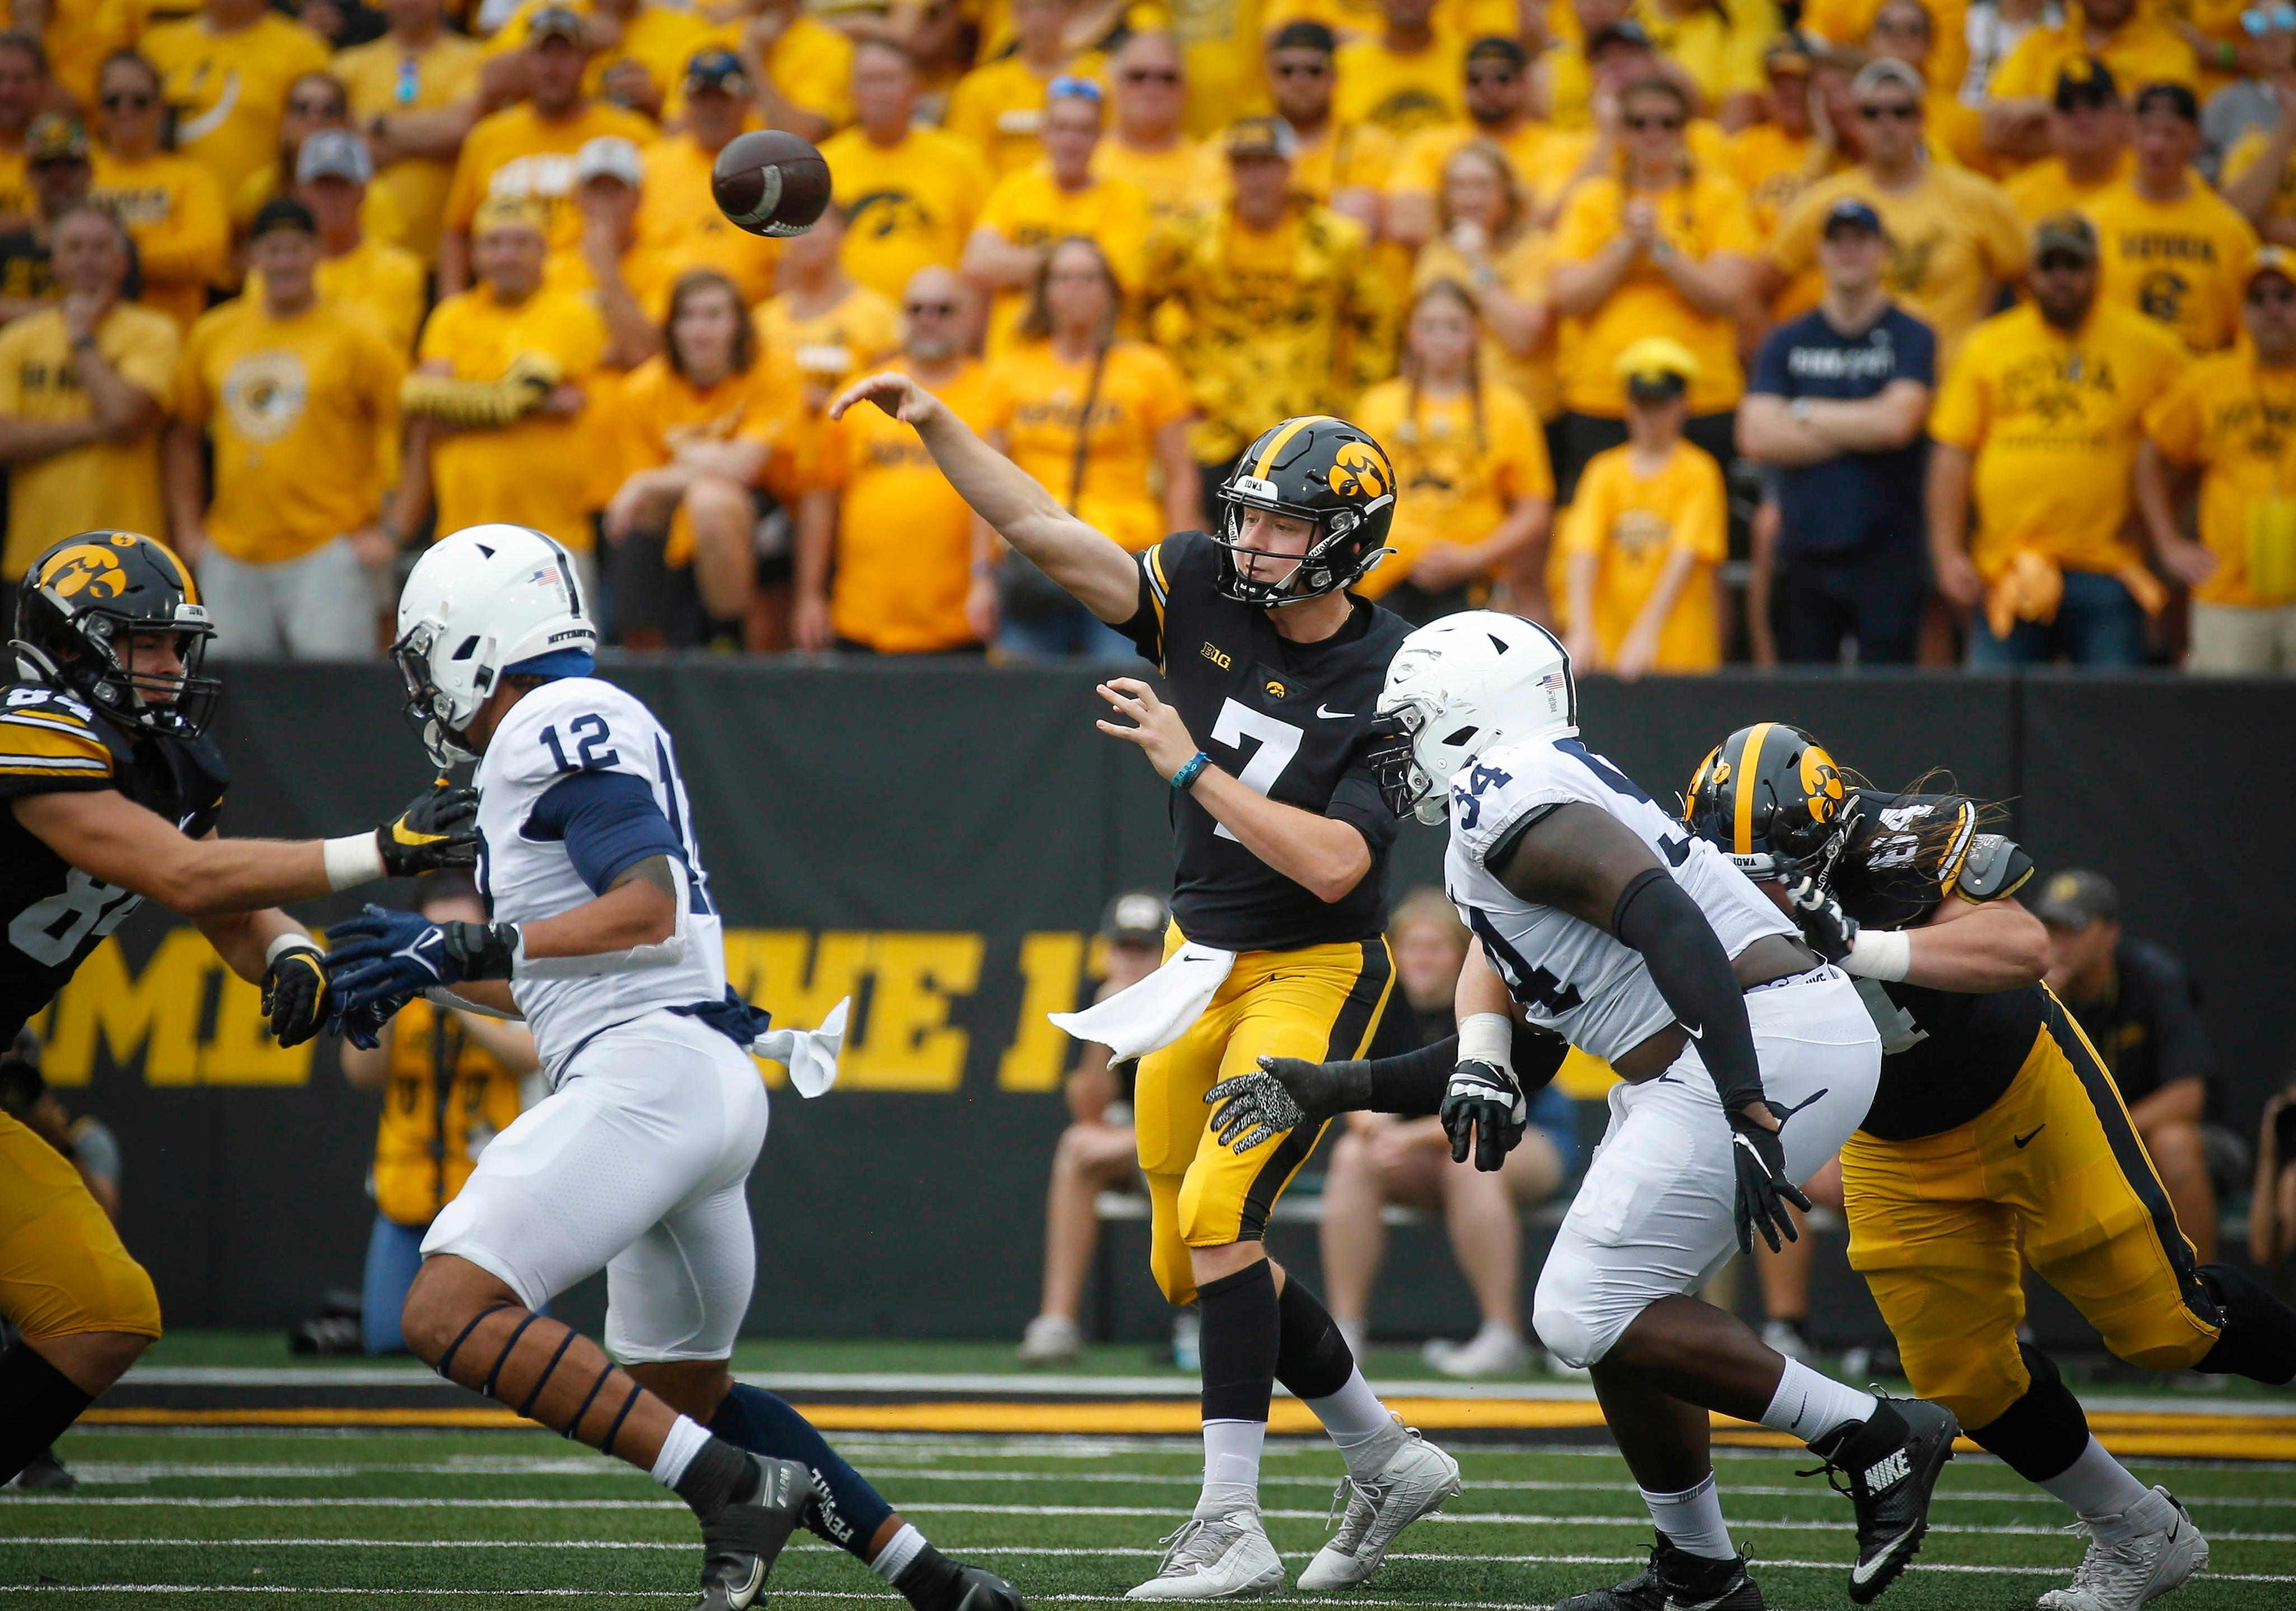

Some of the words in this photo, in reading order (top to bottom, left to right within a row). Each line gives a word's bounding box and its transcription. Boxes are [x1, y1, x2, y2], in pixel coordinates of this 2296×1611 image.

[1244, 479, 1263, 492] IOWA
[539, 713, 620, 773] 12
[1211, 697, 1305, 843] 7
[1733, 857, 1757, 867] IOWA
[1864, 1447, 1911, 1496] NIKE
